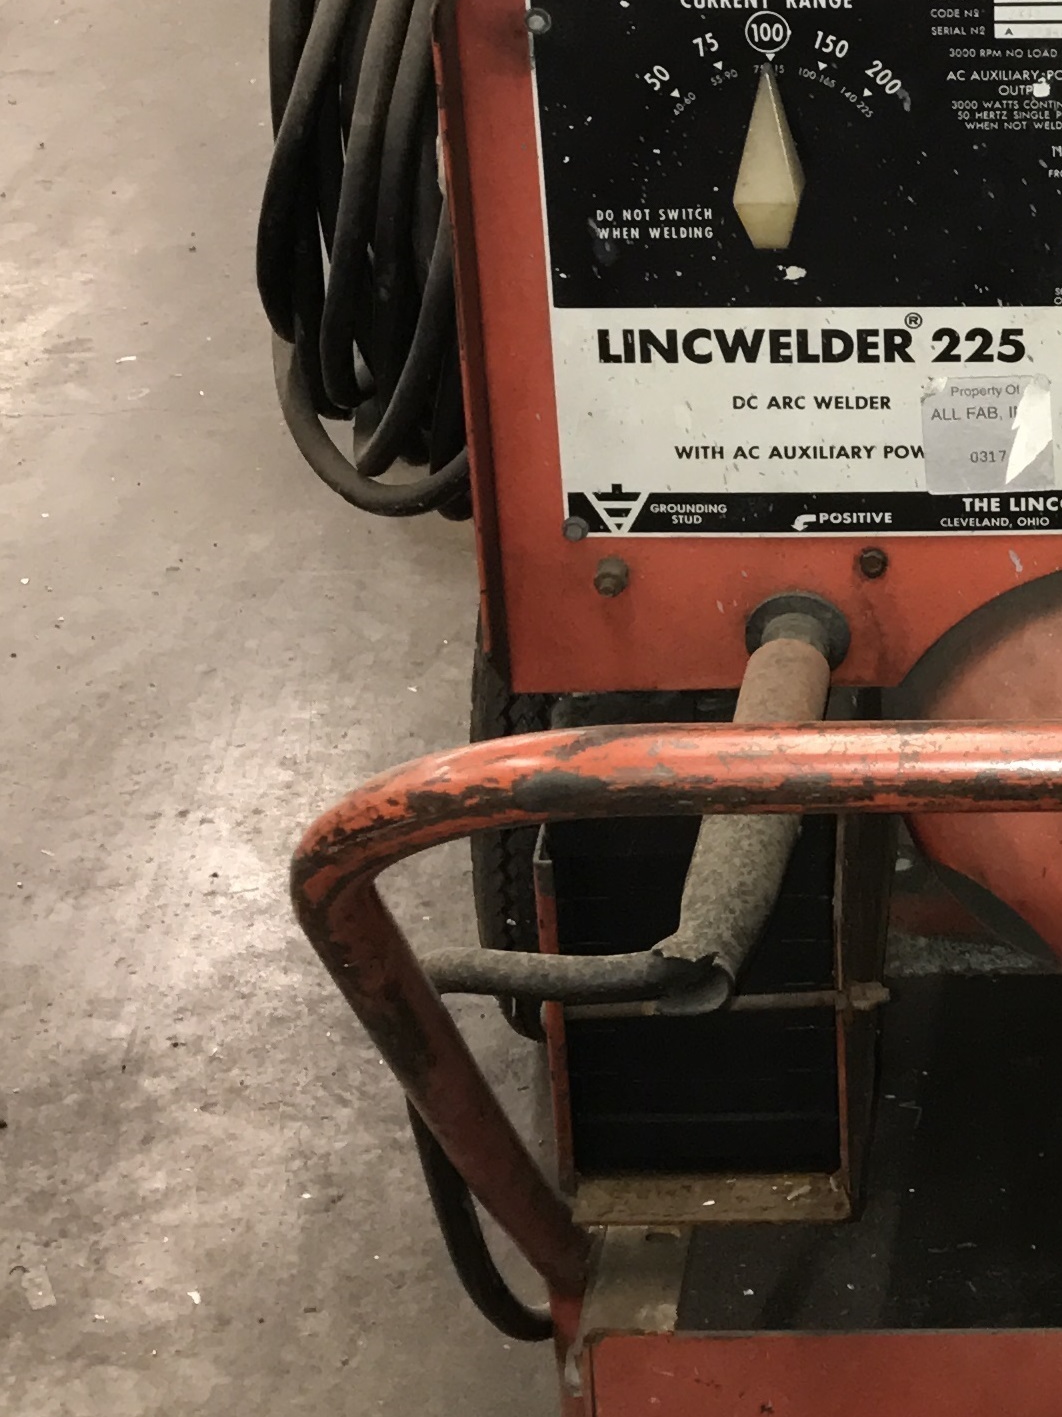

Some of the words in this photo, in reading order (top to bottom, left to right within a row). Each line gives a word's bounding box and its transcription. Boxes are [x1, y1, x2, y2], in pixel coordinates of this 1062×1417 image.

[930, 8, 961, 19] CODE
[751, 22, 784, 42] 100
[931, 26, 967, 36] SERIAL
[1004, 27, 1014, 35] A
[692, 32, 719, 57] 75
[814, 30, 849, 58] 150
[949, 48, 976, 58] 3000
[979, 48, 1002, 58] RPM
[1005, 48, 1024, 58] NO
[1027, 48, 1058, 58] LOAD
[643, 65, 670, 91] 50
[865, 59, 902, 95] 200
[946, 69, 966, 81] AC
[970, 69, 1040, 81] AUXILIARY
[951, 100, 978, 110] 3000
[982, 100, 1019, 109] WATTS
[957, 111, 970, 120] 50
[975, 110, 1008, 120] HERTZ
[1013, 111, 1050, 120] SINGLE
[964, 121, 999, 130] WHEN
[1003, 121, 1027, 130] NOT
[596, 209, 613, 221] DO
[622, 209, 650, 221] NOT
[658, 208, 713, 221] SWITCH
[598, 227, 640, 240] WHEN
[649, 227, 714, 240] WELDING
[597, 327, 915, 363] LINCWELDER
[931, 327, 1026, 363] 225
[950, 385, 1003, 399] Property
[732, 395, 759, 410] DC
[766, 395, 806, 410] ARC
[813, 395, 892, 410] WELDER
[930, 408, 962, 421] ALL
[674, 445, 724, 460] WITH
[733, 445, 760, 460] AC
[768, 445, 876, 460] AUXILIARY
[969, 450, 1007, 463] 0317
[650, 504, 728, 514] GROUNDING
[963, 497, 1001, 512] THE
[671, 514, 703, 525] STUD
[819, 512, 893, 524] POSITIVE
[940, 517, 1013, 528] CLEVELAND,
[1017, 516, 1050, 527] OHIO
